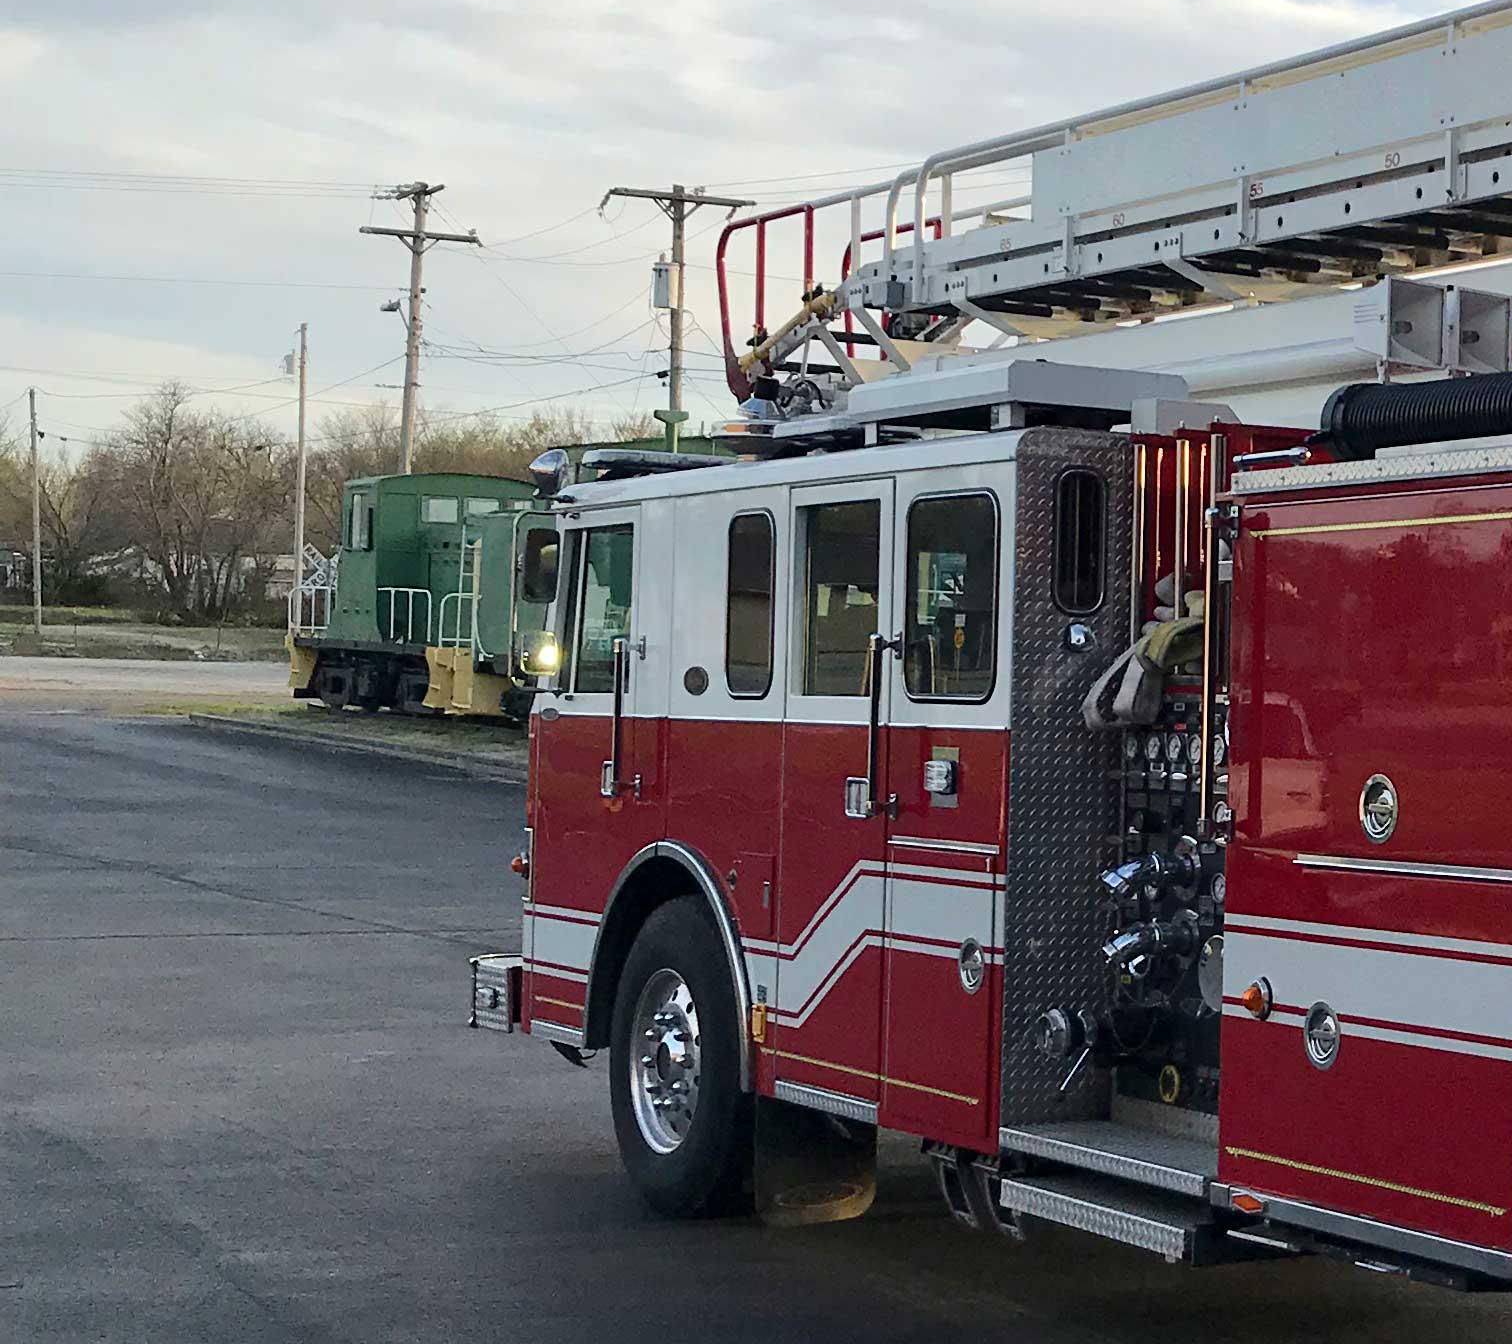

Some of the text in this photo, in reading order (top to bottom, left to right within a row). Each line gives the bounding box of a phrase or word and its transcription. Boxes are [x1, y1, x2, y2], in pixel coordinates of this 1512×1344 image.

[1384, 152, 1400, 168] 50
[1250, 182, 1263, 197] 55
[1113, 213, 1125, 226] 60
[985, 857, 990, 872] 1
